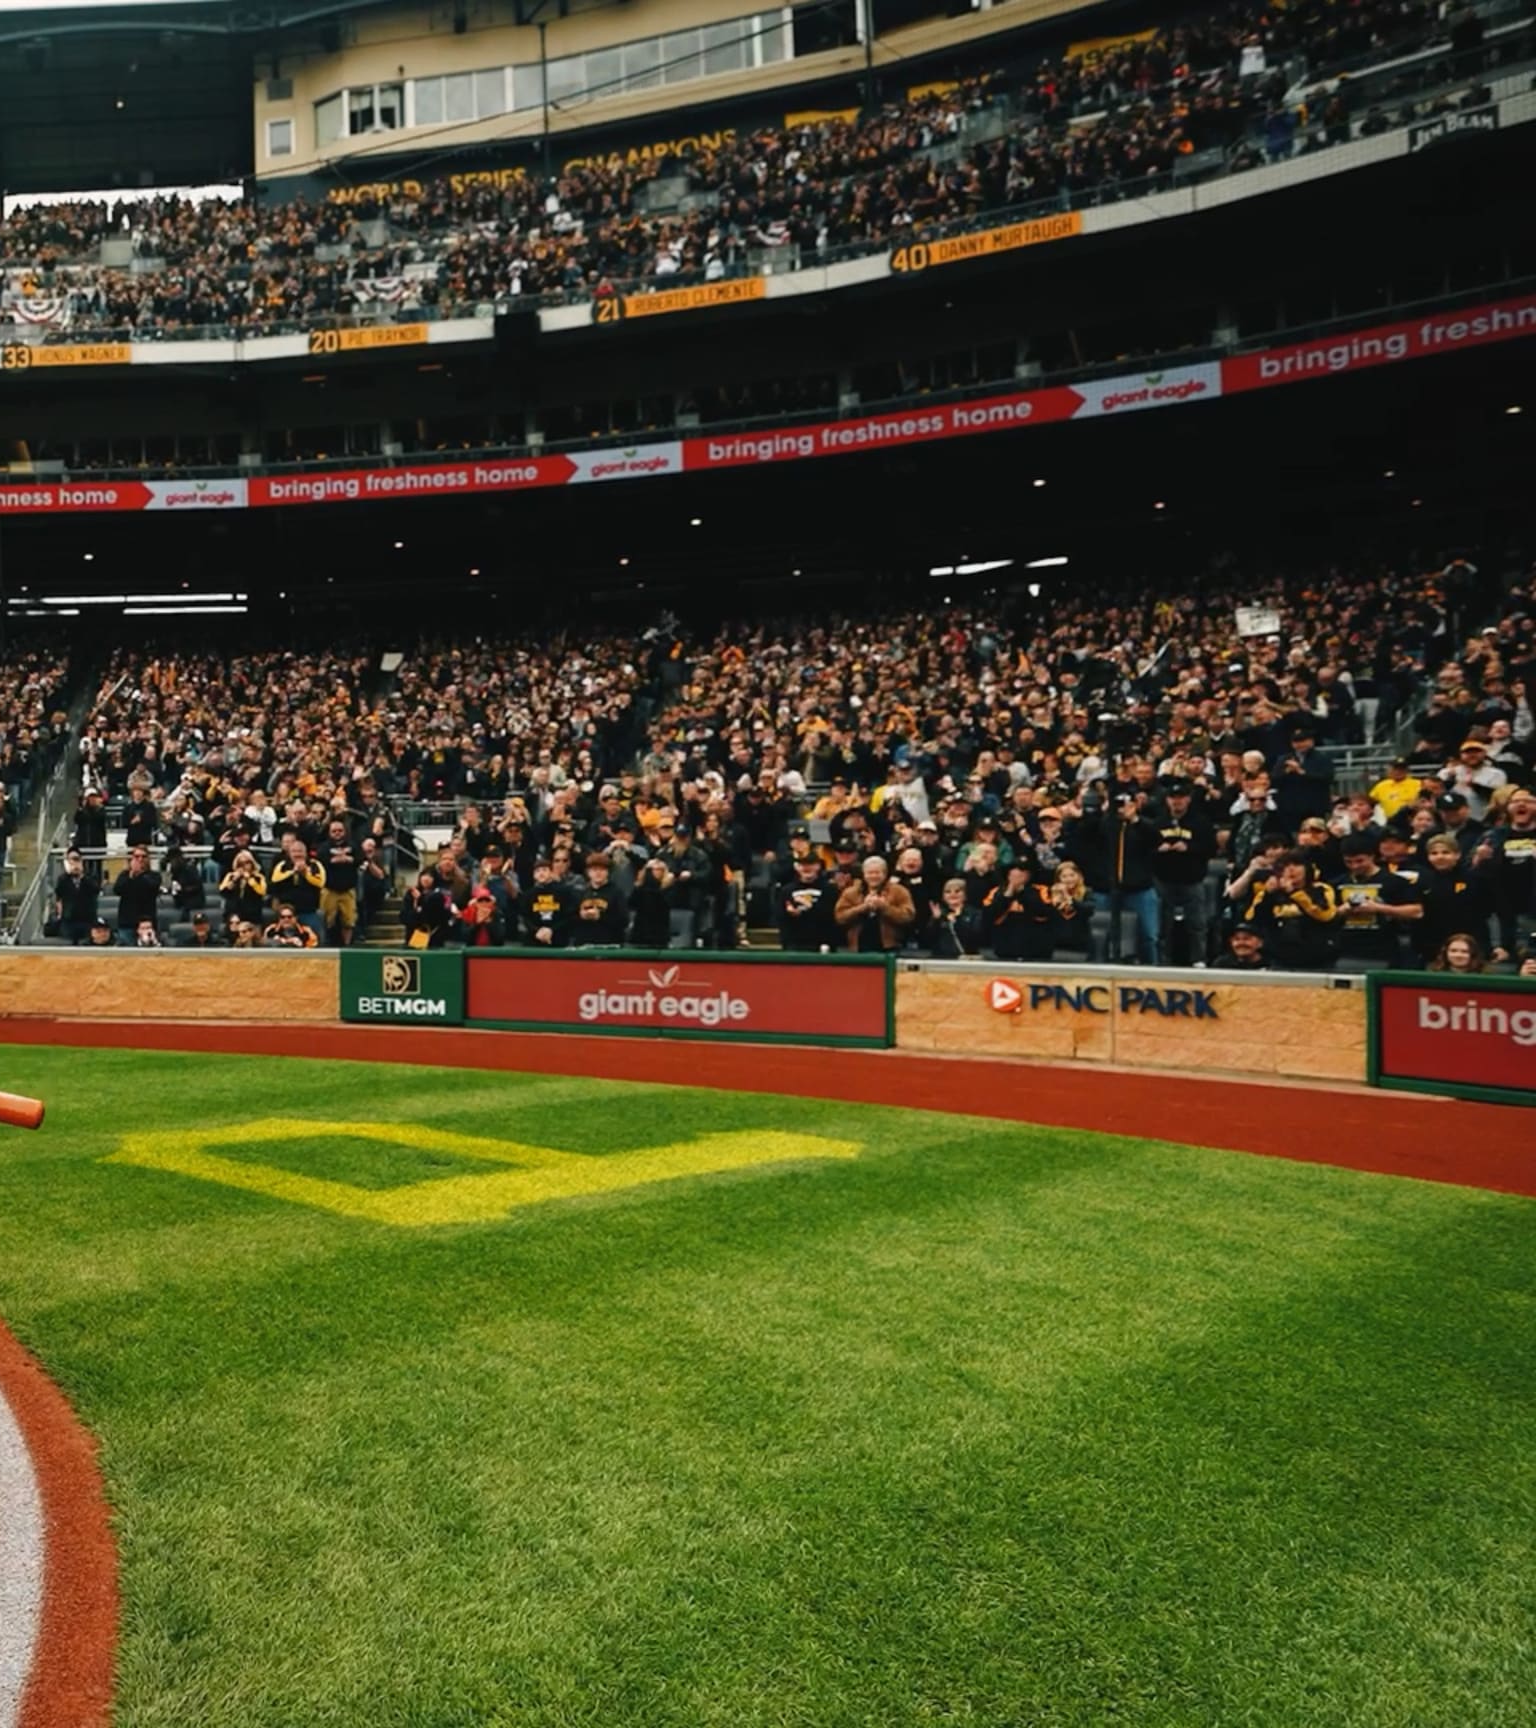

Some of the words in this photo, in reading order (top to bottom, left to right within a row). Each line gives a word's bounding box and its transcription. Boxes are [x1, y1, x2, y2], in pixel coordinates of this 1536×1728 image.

[891, 244, 928, 272] 40
[938, 237, 986, 262] DANNY
[992, 215, 1073, 250] MURTAUGH
[597, 298, 620, 323] 21
[634, 290, 689, 313] ROBERTO
[693, 279, 758, 306] CLEMENTE
[4, 346, 31, 369] 33
[310, 330, 339, 353] 20
[1260, 333, 1408, 379] bringing
[1102, 387, 1149, 411] giant
[1151, 379, 1207, 401] eagle
[709, 434, 814, 461] bringing
[821, 414, 944, 449] freshness
[952, 401, 1033, 429] home
[270, 478, 360, 501] bringing
[366, 471, 468, 492] freshness
[474, 466, 538, 485] home
[591, 460, 625, 478] giant
[627, 456, 669, 474] eagle
[58, 487, 118, 506] home
[357, 996, 446, 1016] BETMGM
[578, 988, 656, 1021] giant
[659, 990, 750, 1026] eagle
[1026, 983, 1111, 1014] PNC
[1117, 986, 1220, 1019] PARK
[1418, 996, 1536, 1046] bring
